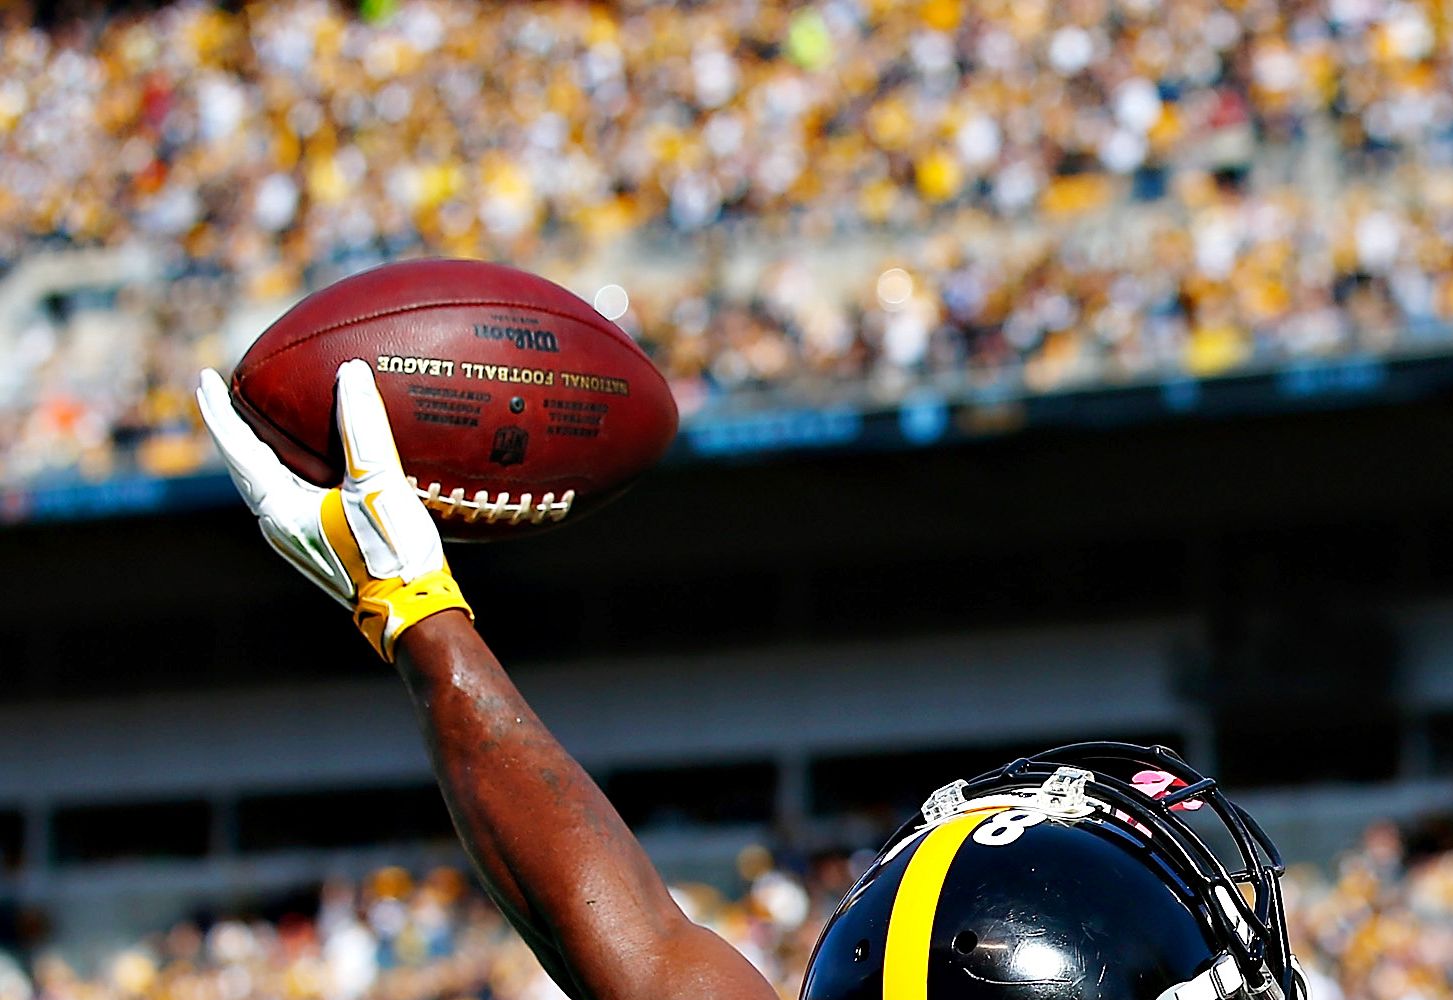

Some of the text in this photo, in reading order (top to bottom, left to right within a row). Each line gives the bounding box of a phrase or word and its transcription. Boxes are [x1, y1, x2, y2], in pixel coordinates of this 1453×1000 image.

[473, 325, 560, 352] Wilson
[376, 354, 629, 396] NATIONAL FOOTBALL LEAGUE
